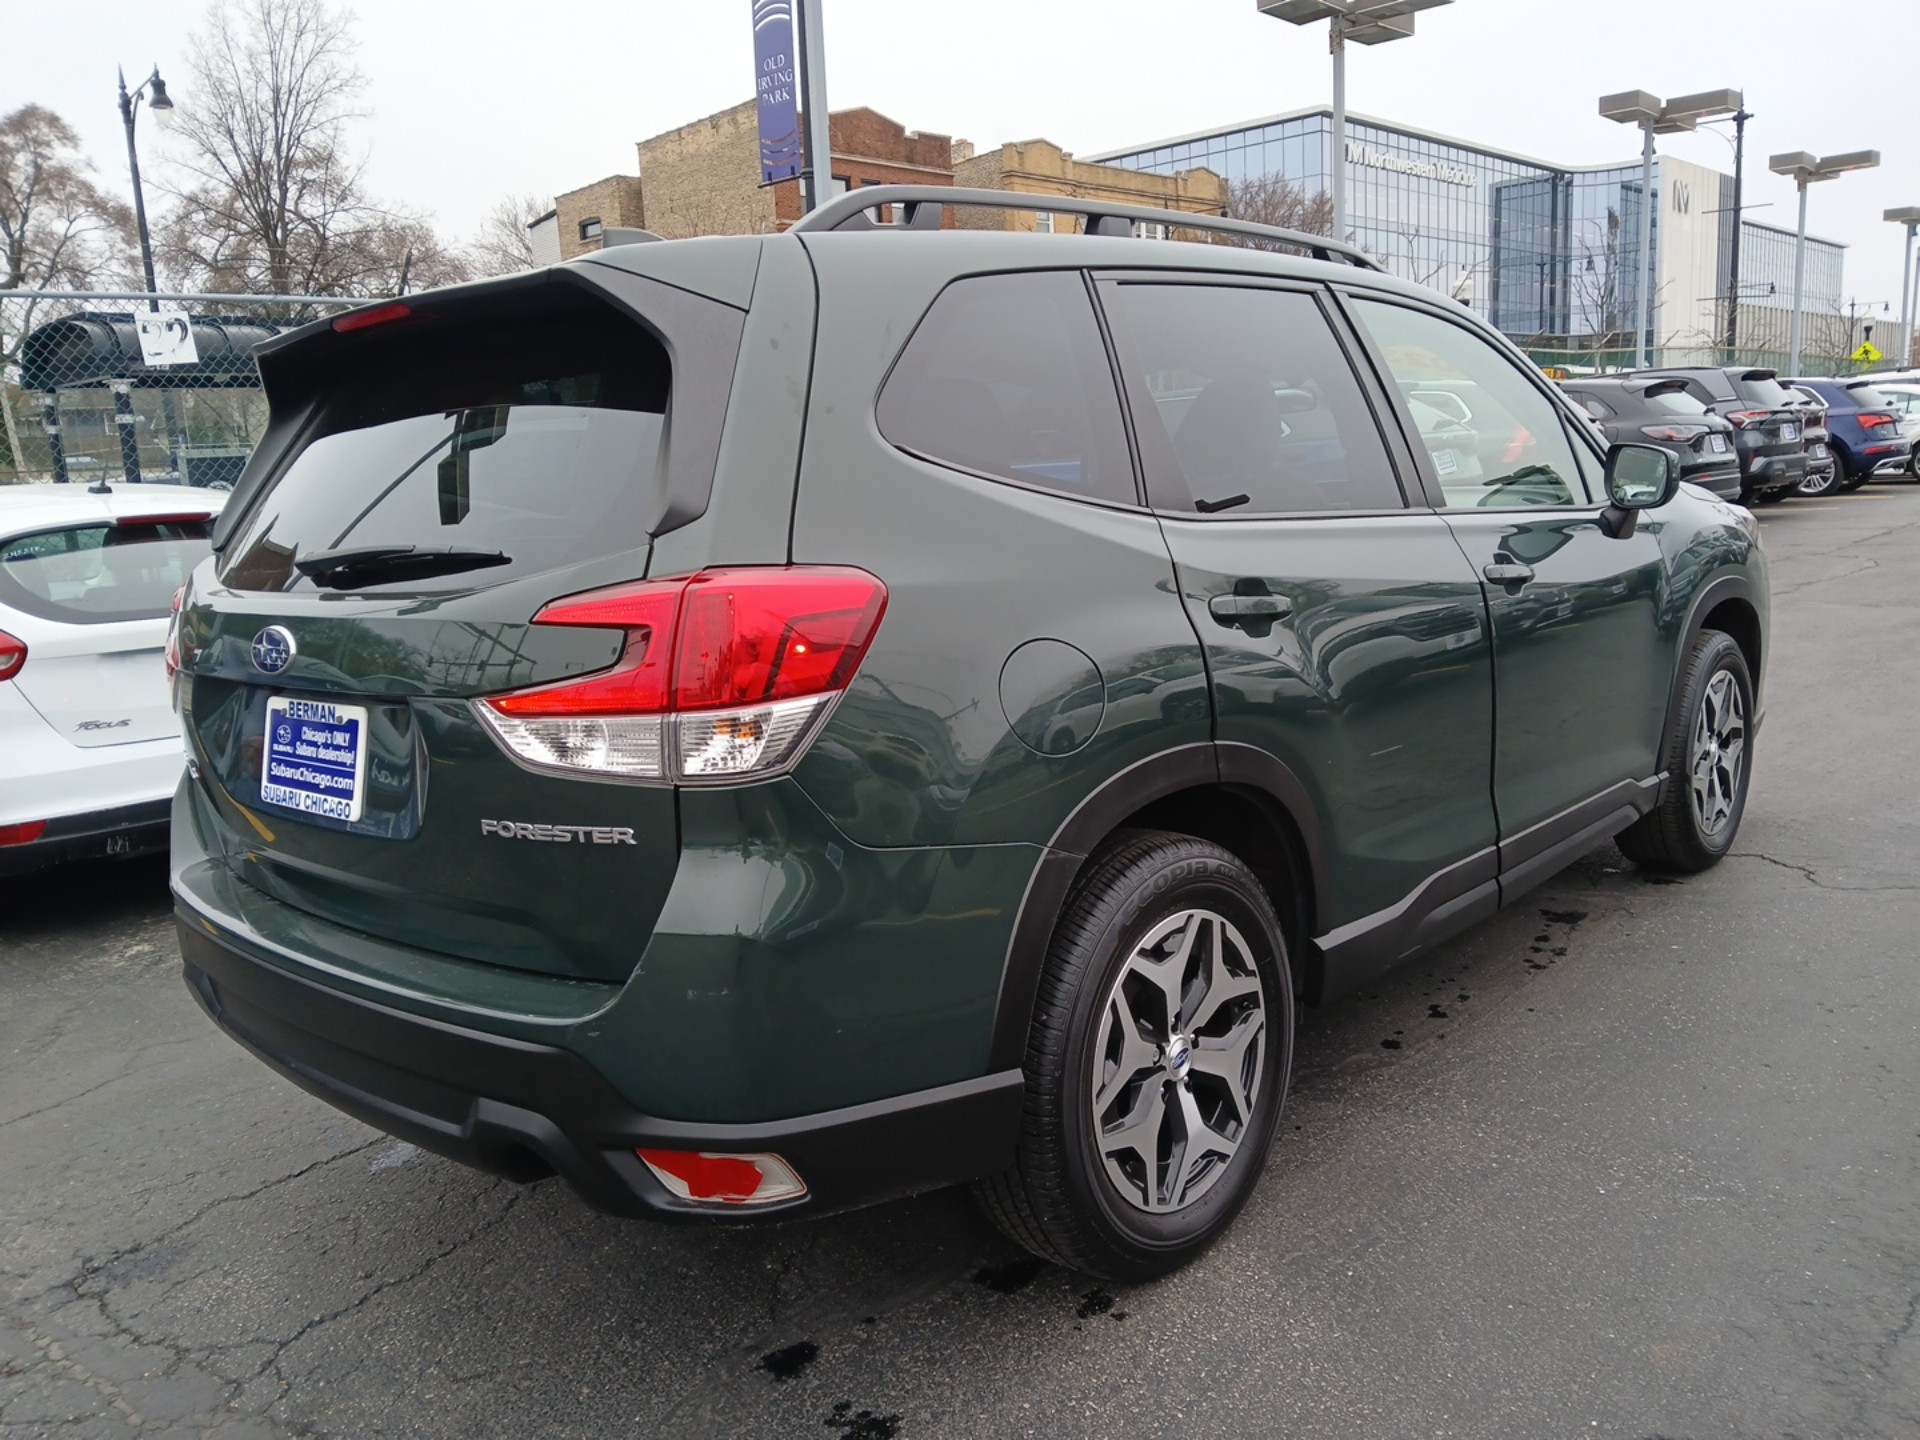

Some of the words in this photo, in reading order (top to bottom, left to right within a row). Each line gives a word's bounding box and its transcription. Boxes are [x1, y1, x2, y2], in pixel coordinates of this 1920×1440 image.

[763, 53, 785, 72] OLD
[757, 68, 793, 92] IRVING
[761, 87, 791, 106] PARK
[1364, 146, 1436, 180] Northwestern
[1437, 162, 1477, 188] Medicine
[288, 701, 336, 723] BERMAN
[301, 726, 332, 745] Chicago's
[333, 731, 351, 746] ONLY
[295, 742, 317, 758] Subaru
[318, 746, 355, 766] dealership!
[270, 762, 354, 791] SubaruChicago.com
[263, 785, 301, 807] SUBARU
[303, 794, 351, 819] CHICAGO
[480, 818, 638, 845] FORESTER
